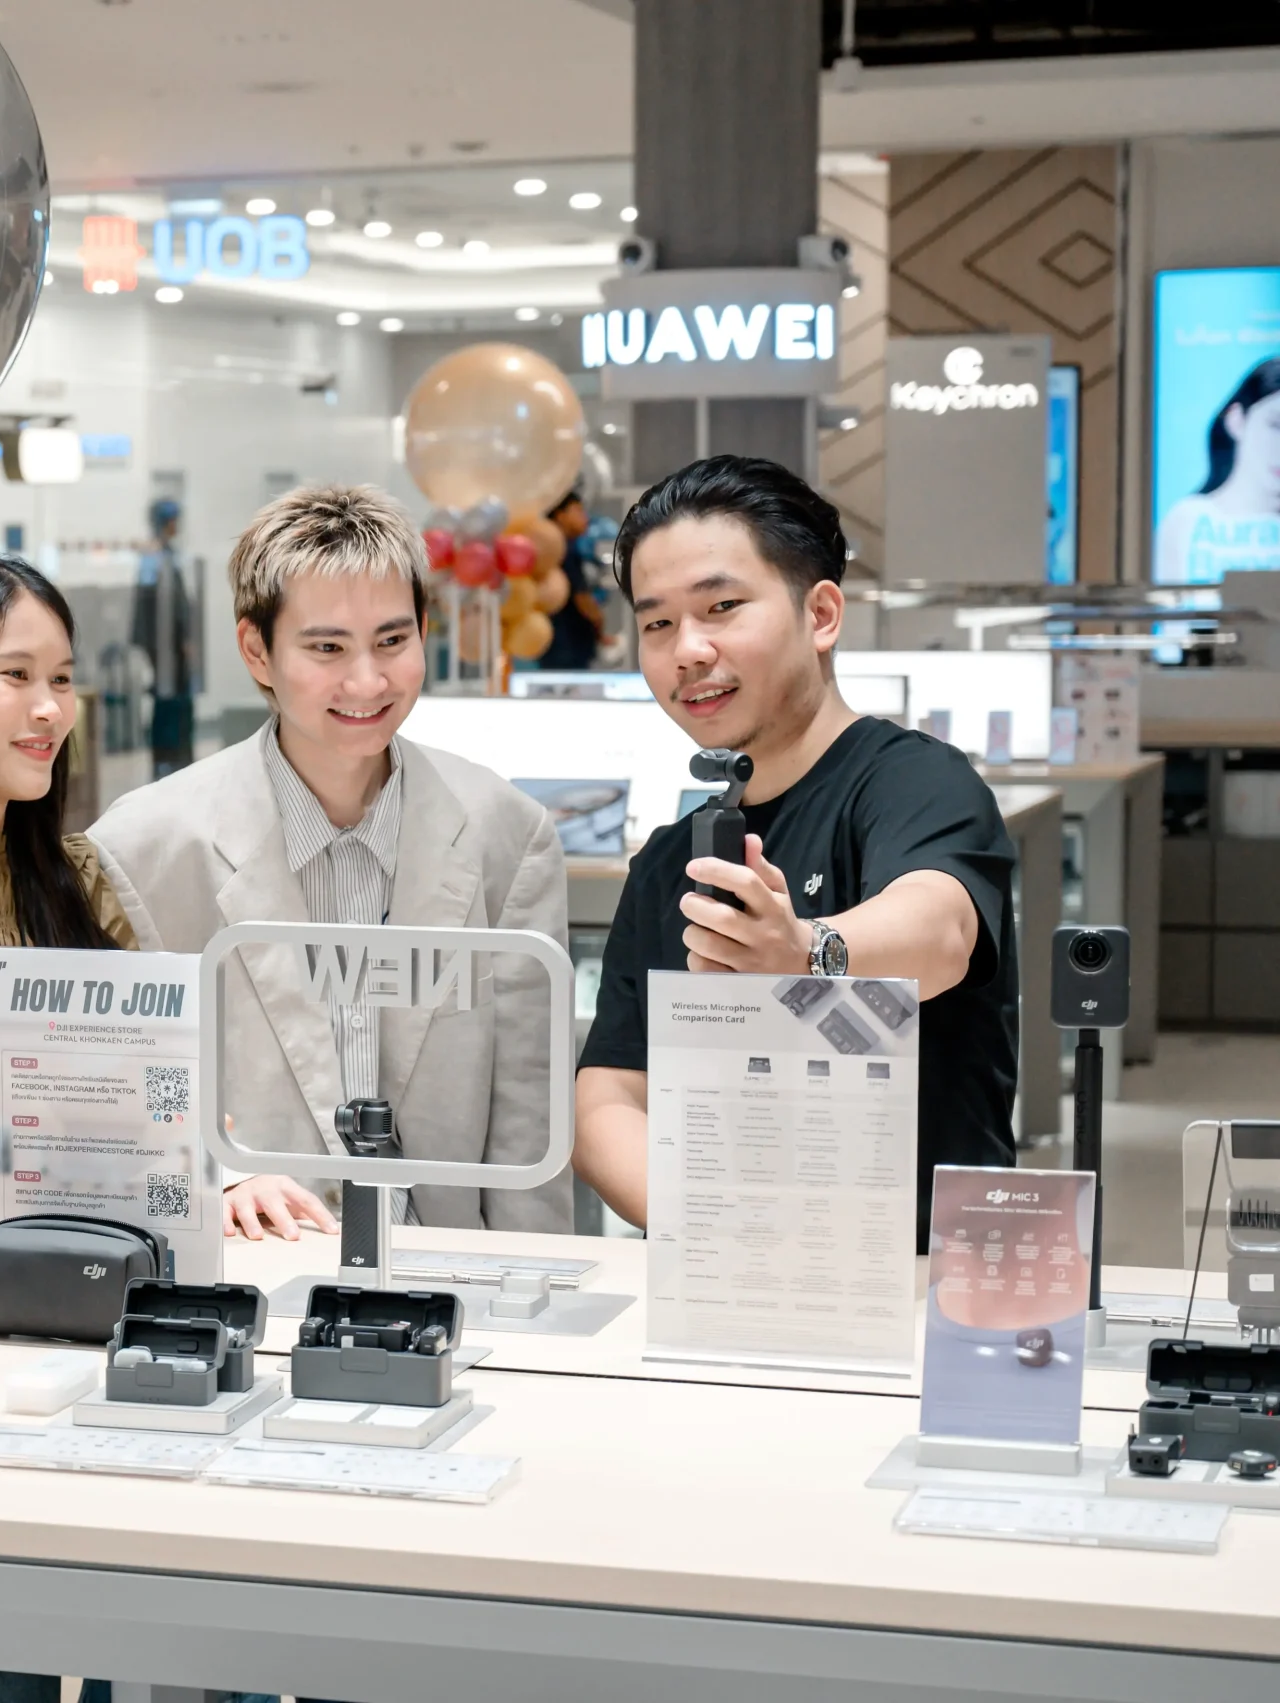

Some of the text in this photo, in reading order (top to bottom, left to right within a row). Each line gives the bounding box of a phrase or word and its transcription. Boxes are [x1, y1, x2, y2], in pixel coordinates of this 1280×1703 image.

[152, 214, 310, 285] UOB
[889, 380, 1039, 414] Keychron
[10, 978, 185, 1018] HOW TO JOIN
[671, 1002, 762, 1013] Wireless Microphone
[671, 1013, 745, 1024] Comparison Card
[56, 1024, 143, 1035] DJI EXPERIENCE STORE
[43, 1034, 156, 1046] CENTRAL KHONKAEN CAMPUS
[13, 1059, 30, 1067] STEP
[11, 1082, 52, 1092] FACEBOOK,
[53, 1085, 96, 1093] INSTAGRAM
[111, 1087, 137, 1095] TIKTOK
[14, 1117, 31, 1125] STEP
[135, 1149, 165, 1157] #DJIKKC
[16, 1172, 34, 1180] STEP
[1011, 1193, 1031, 1202] MIC
[1032, 1193, 1039, 1202] 3
